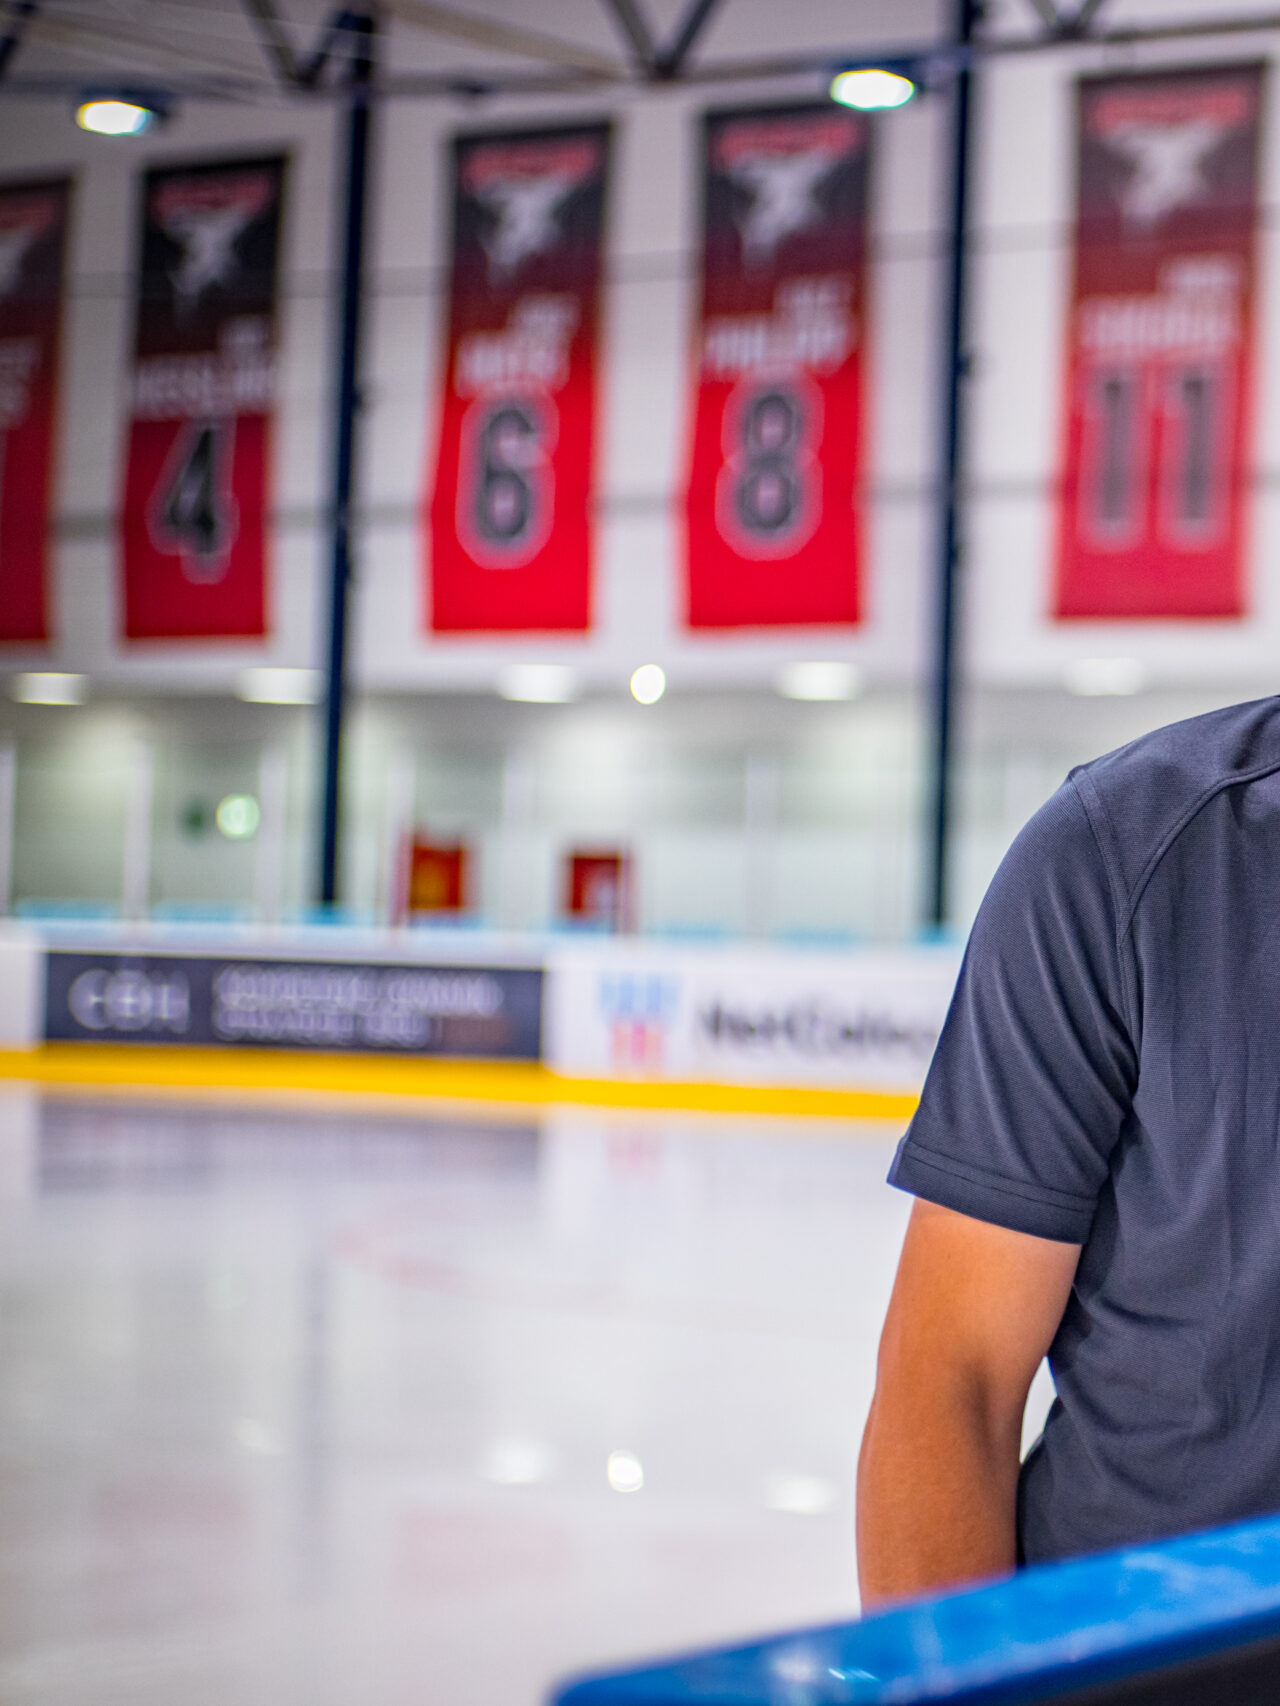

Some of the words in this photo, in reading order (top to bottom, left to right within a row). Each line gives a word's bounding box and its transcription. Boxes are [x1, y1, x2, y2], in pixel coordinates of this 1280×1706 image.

[151, 414, 234, 579] 4
[461, 397, 553, 563] 6
[719, 380, 819, 556] 8
[1083, 366, 1231, 547] 11
